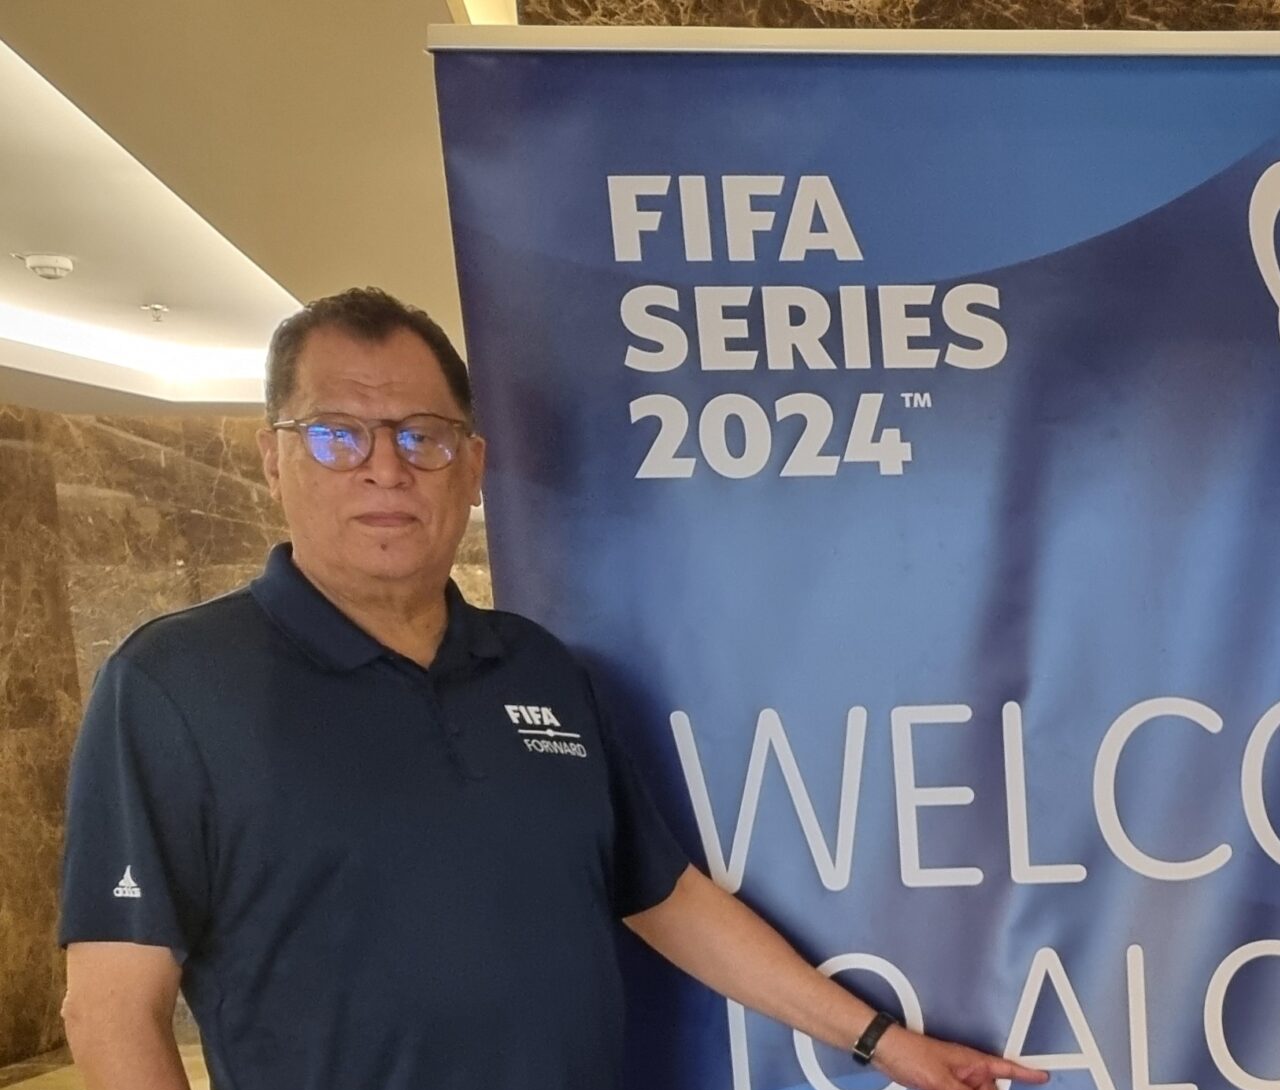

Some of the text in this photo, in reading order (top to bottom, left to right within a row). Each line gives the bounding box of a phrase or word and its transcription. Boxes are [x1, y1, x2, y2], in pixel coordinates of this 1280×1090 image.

[607, 174, 864, 262] FIFA
[619, 282, 1009, 373] SERIES
[503, 704, 562, 727] FIFA
[523, 738, 588, 759] FORWARD
